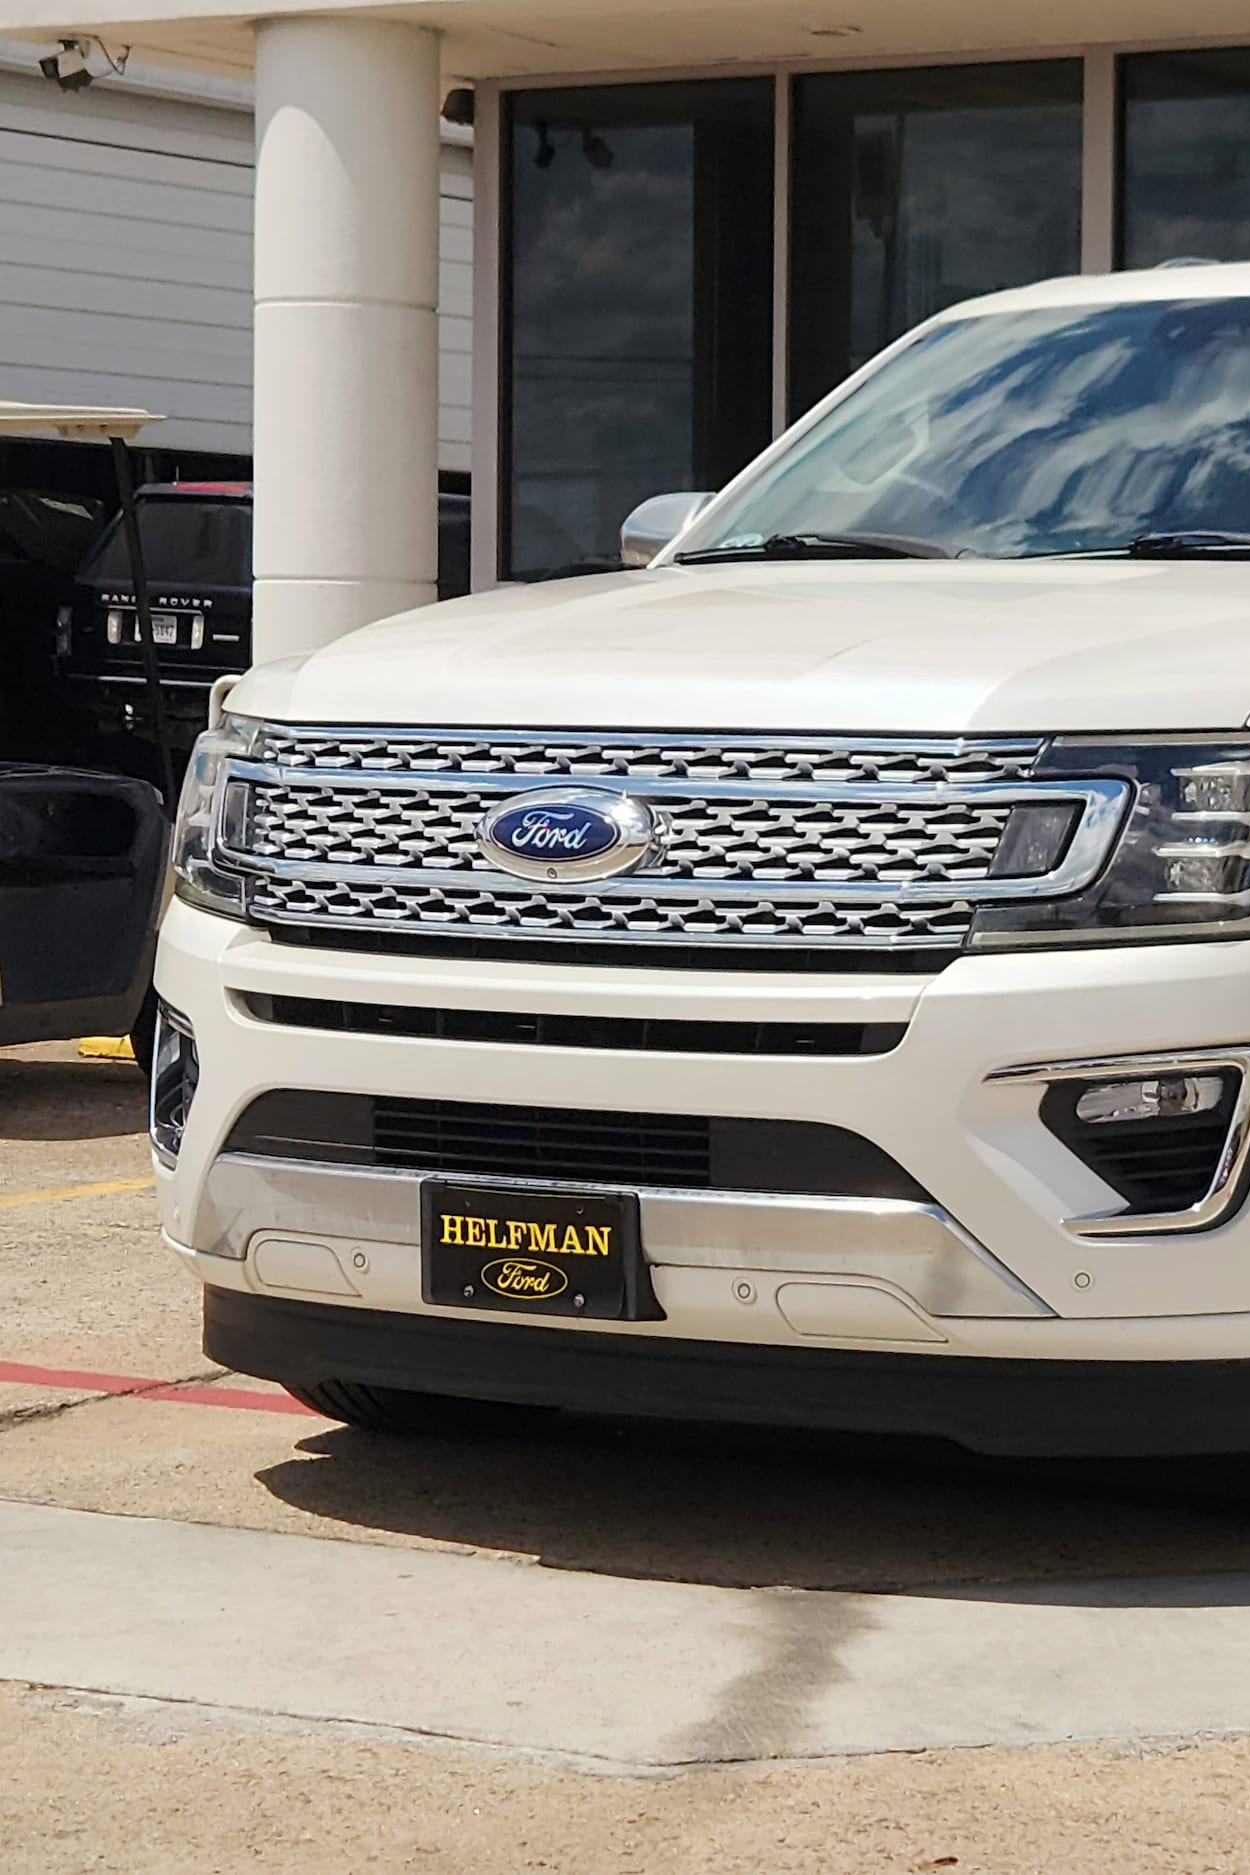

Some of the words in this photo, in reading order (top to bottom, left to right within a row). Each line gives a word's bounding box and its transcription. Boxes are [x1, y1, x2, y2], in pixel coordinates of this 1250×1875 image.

[159, 597, 213, 608] ROVER
[512, 811, 592, 849] Ford
[440, 1214, 612, 1256] HELFMAN
[497, 1262, 550, 1292] Ford
